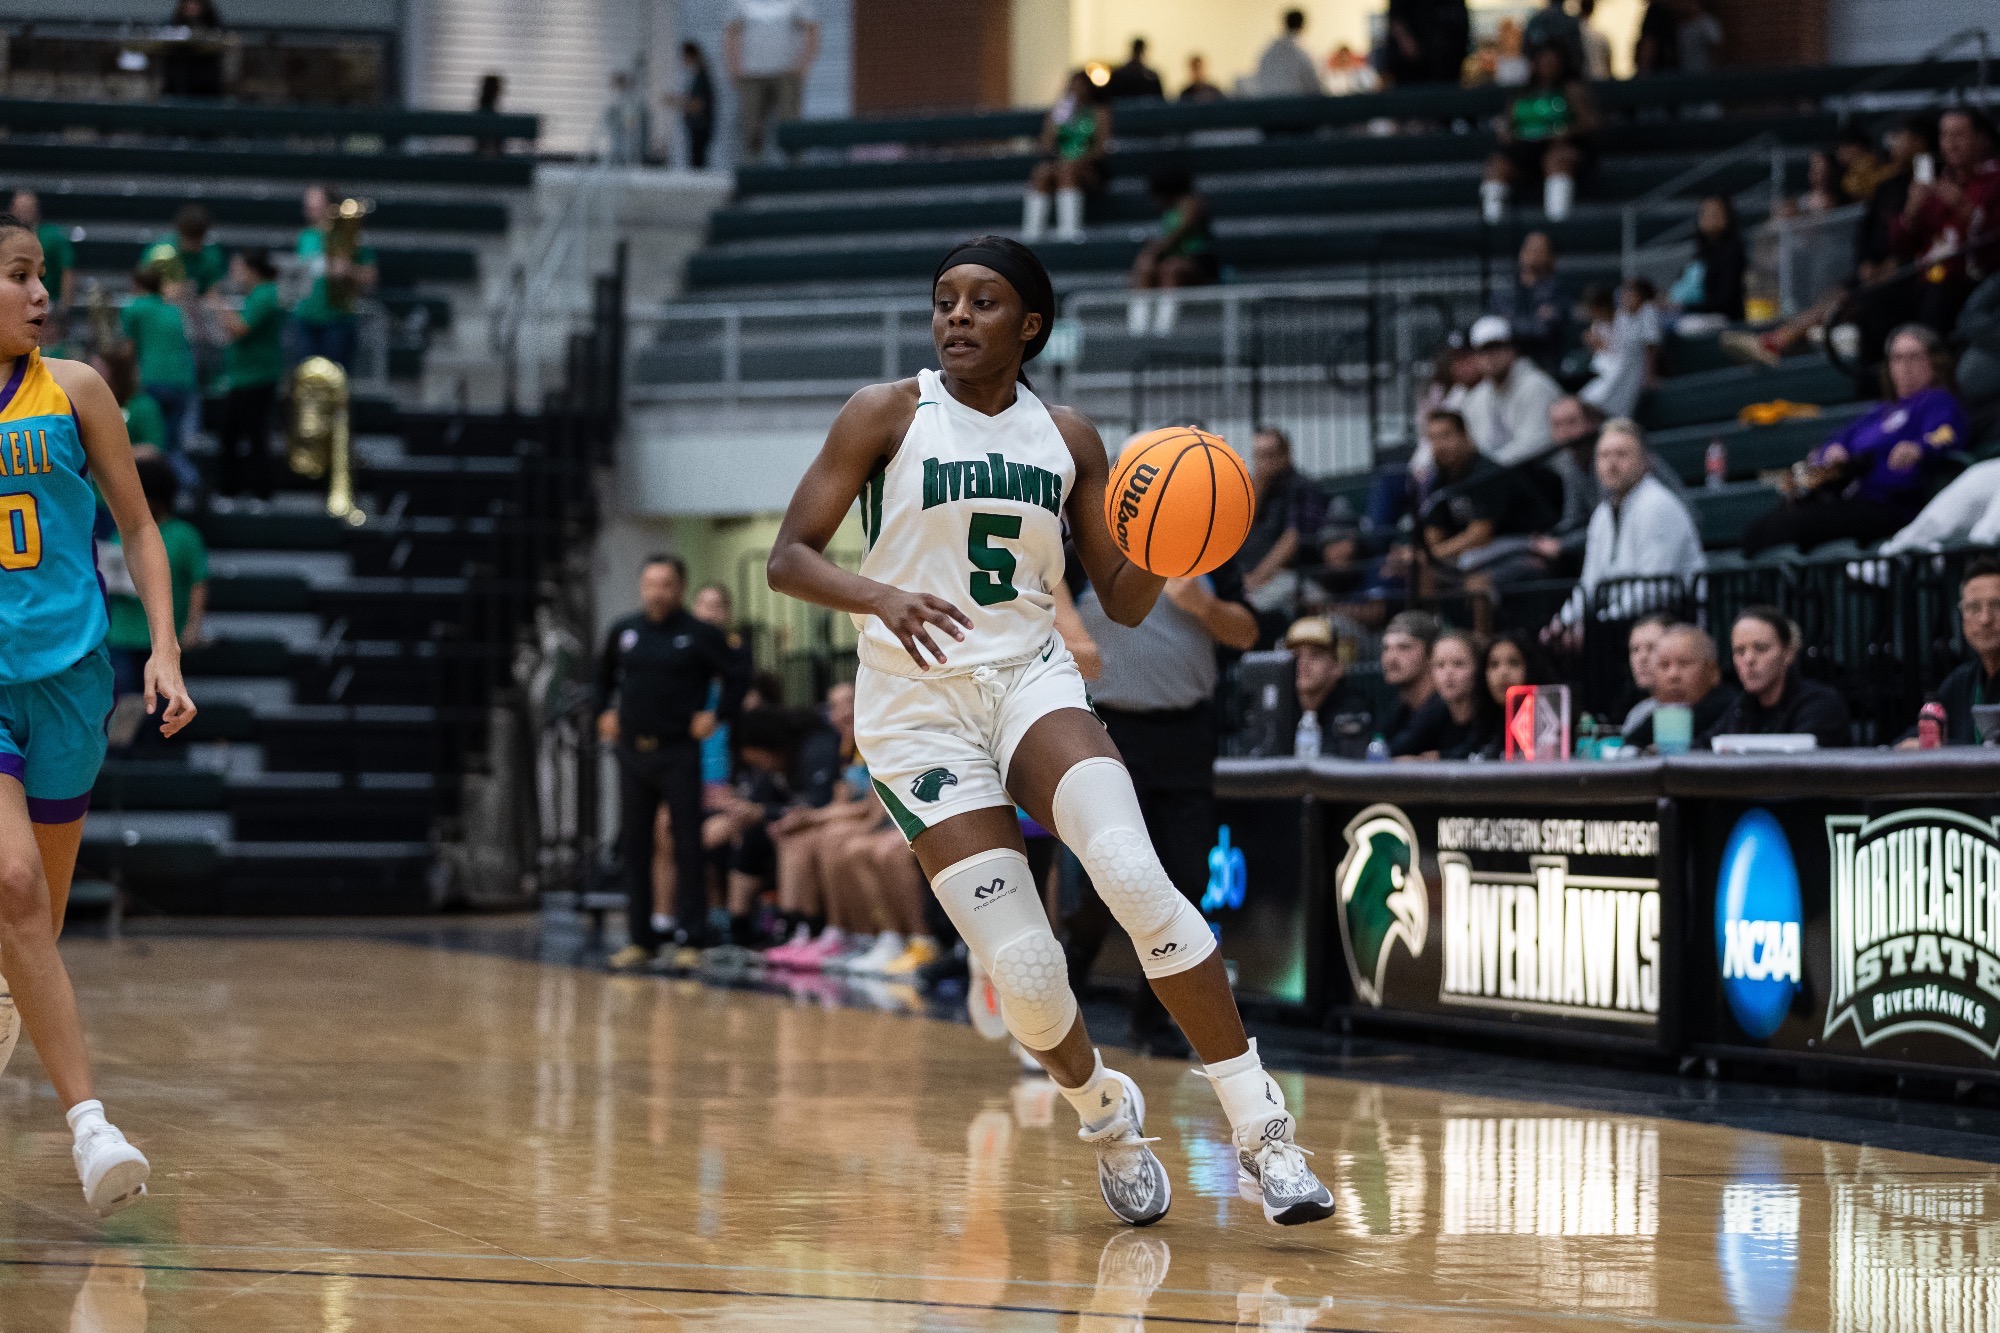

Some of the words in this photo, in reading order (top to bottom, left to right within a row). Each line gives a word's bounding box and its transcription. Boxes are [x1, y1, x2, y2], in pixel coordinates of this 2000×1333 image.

[922, 453, 1062, 517] RIVERHAWKS
[968, 512, 1022, 606] 5
[1438, 817, 1542, 850] NORTHEASTERN
[1541, 818, 1585, 855] STATE
[1445, 862, 1660, 1013] RIVERHAWKS
[1723, 919, 1801, 983] NCAA
[1856, 934, 2000, 1000] STATE
[1872, 983, 1986, 1029] RIVERHAWKS
